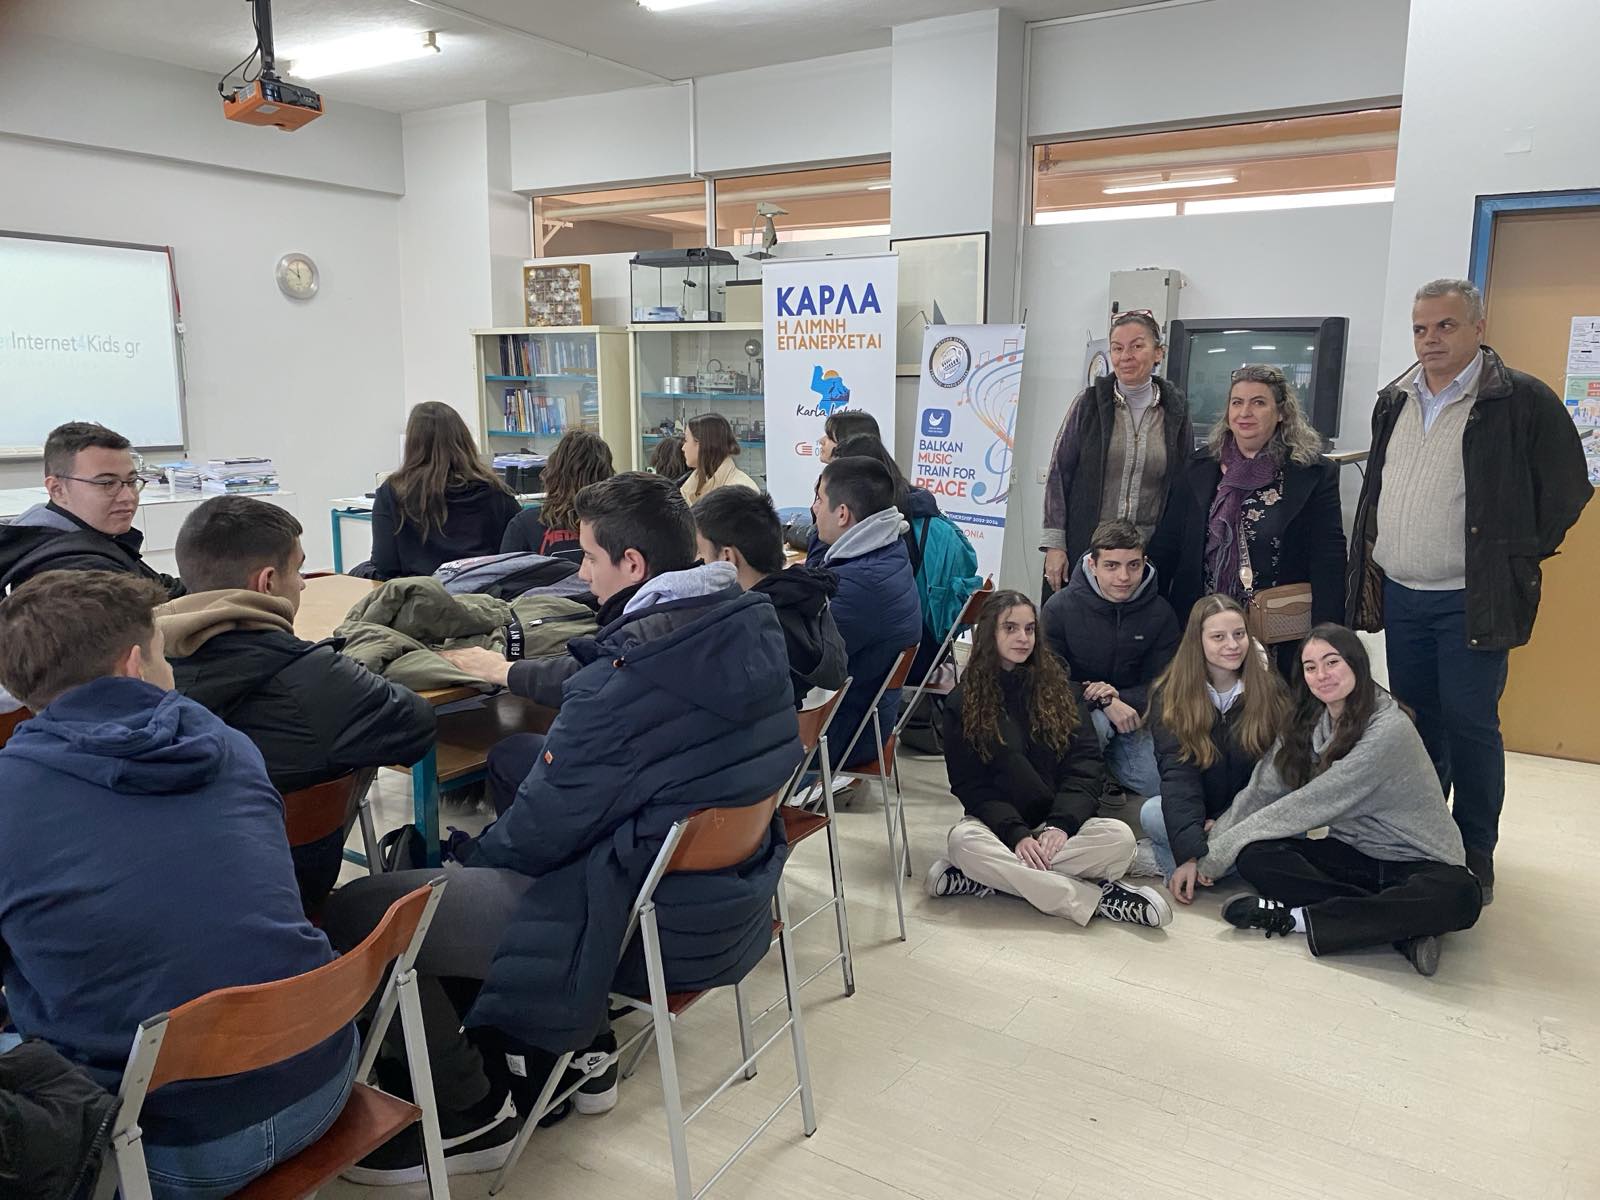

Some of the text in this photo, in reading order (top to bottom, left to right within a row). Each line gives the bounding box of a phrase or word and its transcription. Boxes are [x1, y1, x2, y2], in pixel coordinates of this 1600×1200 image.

[777, 282, 881, 316] ΚΑΡΛΑ
[777, 318, 846, 334] Η ΛΙΜΝΗ
[777, 333, 882, 350] ΕΠΑΝΕΡΧΕΤΑΙ
[796, 403, 827, 417] Karla
[919, 440, 964, 453] BALKAN
[918, 452, 953, 465] MUSIC
[917, 464, 976, 480] TRAIN FOR
[963, 529, 985, 540] ONIA
[510, 630, 521, 656] FOR NY
